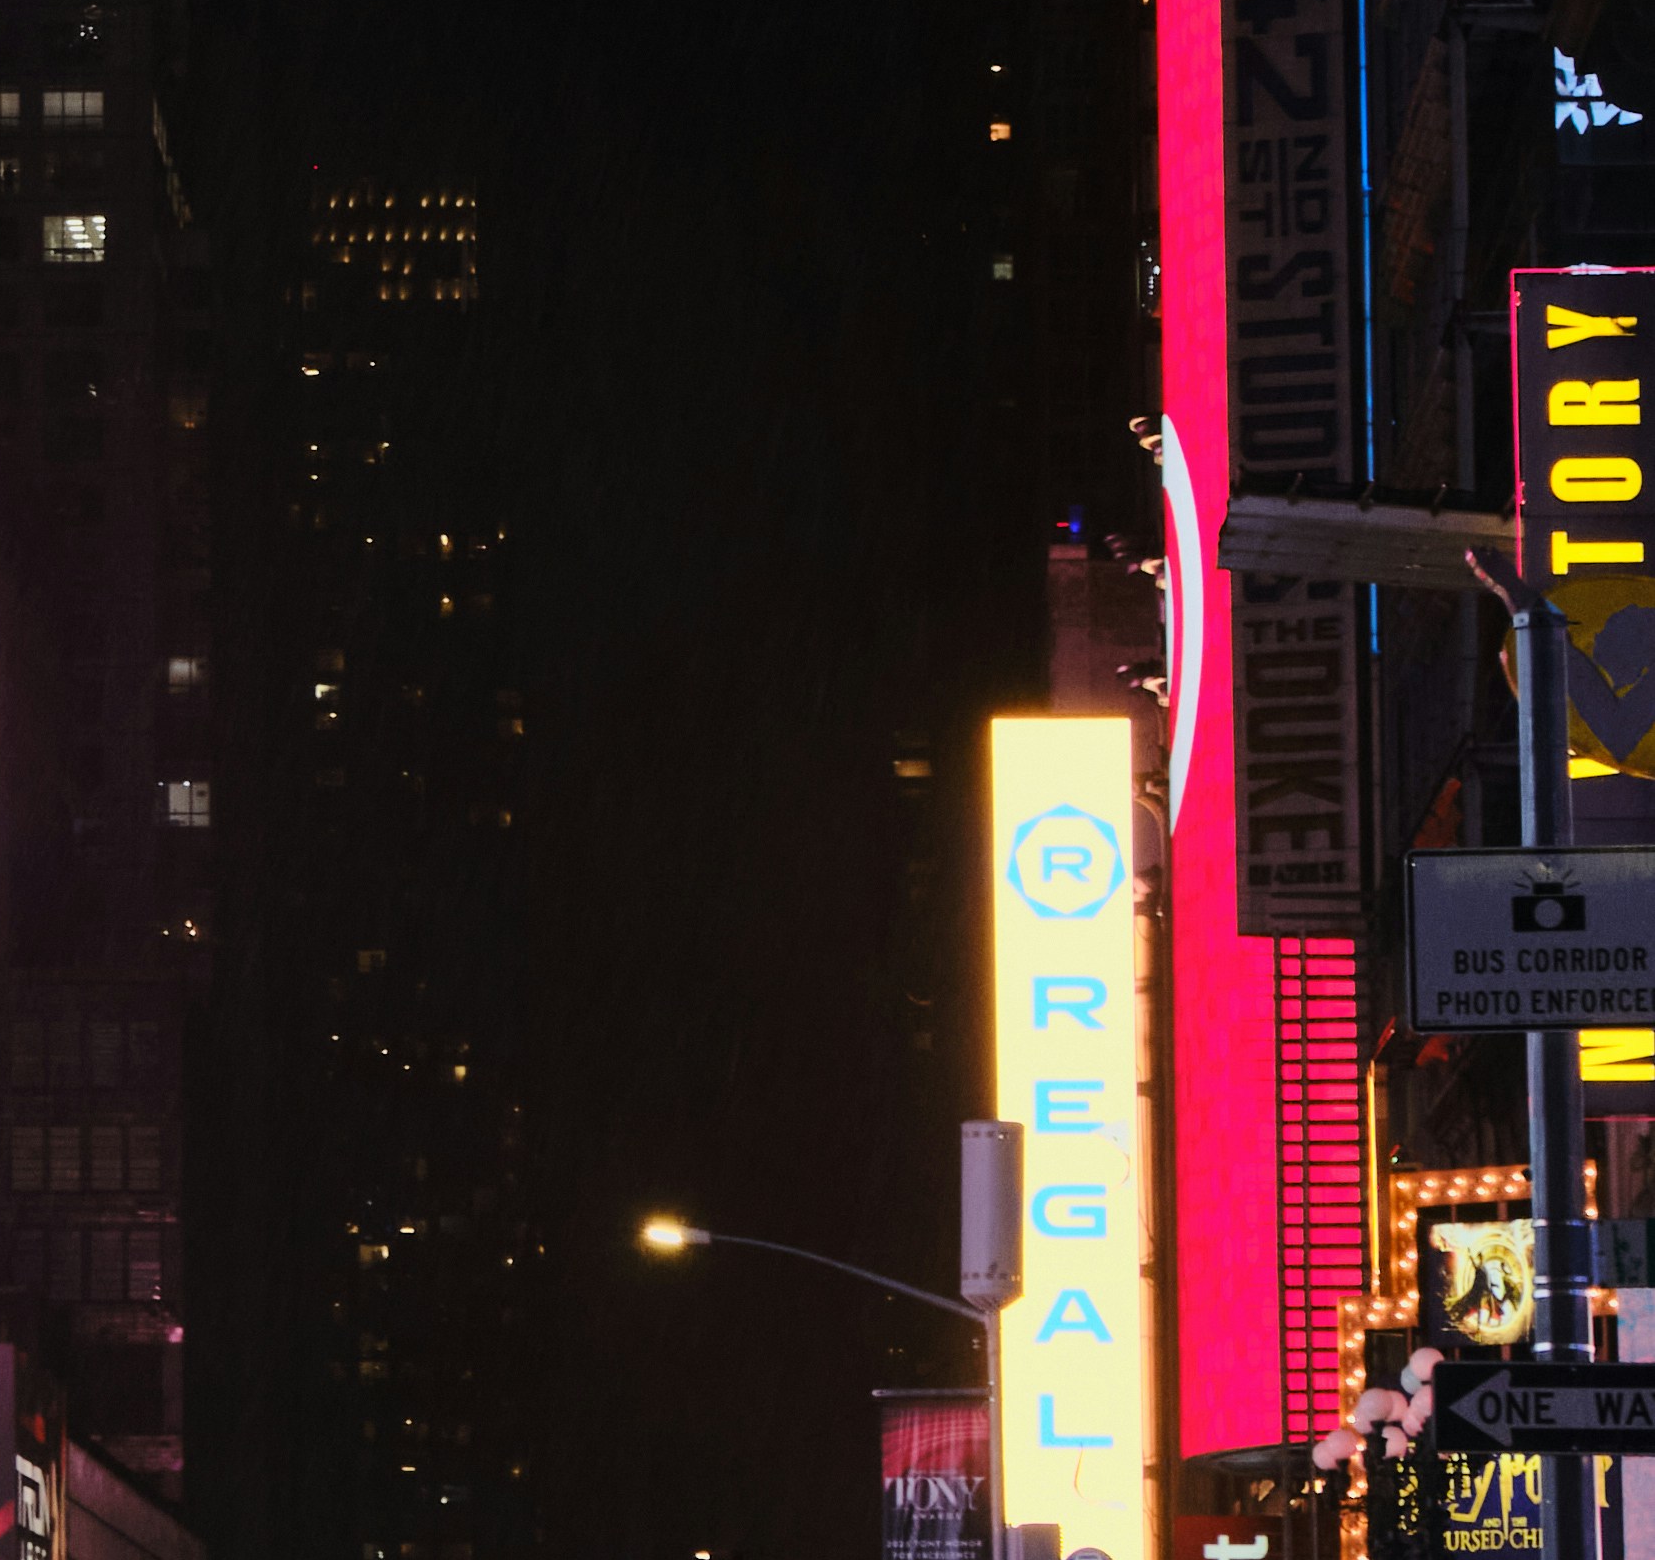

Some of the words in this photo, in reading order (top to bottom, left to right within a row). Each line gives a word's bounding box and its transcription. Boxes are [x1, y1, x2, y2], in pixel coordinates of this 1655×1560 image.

[1244, 650, 1341, 851] DUKE
[1453, 949, 1505, 975] BUS
[1516, 947, 1648, 974] CORRIDOR
[1436, 990, 1521, 1017] PHOTO
[1028, 974, 1115, 1449] REGAL
[1477, 1392, 1556, 1425] ONE
[884, 1477, 986, 1510] TONY
[1482, 1518, 1502, 1529] AND
[1511, 1517, 1528, 1528] THE
[1443, 1528, 1505, 1553] URSED
[1509, 1528, 1544, 1550] CHI
